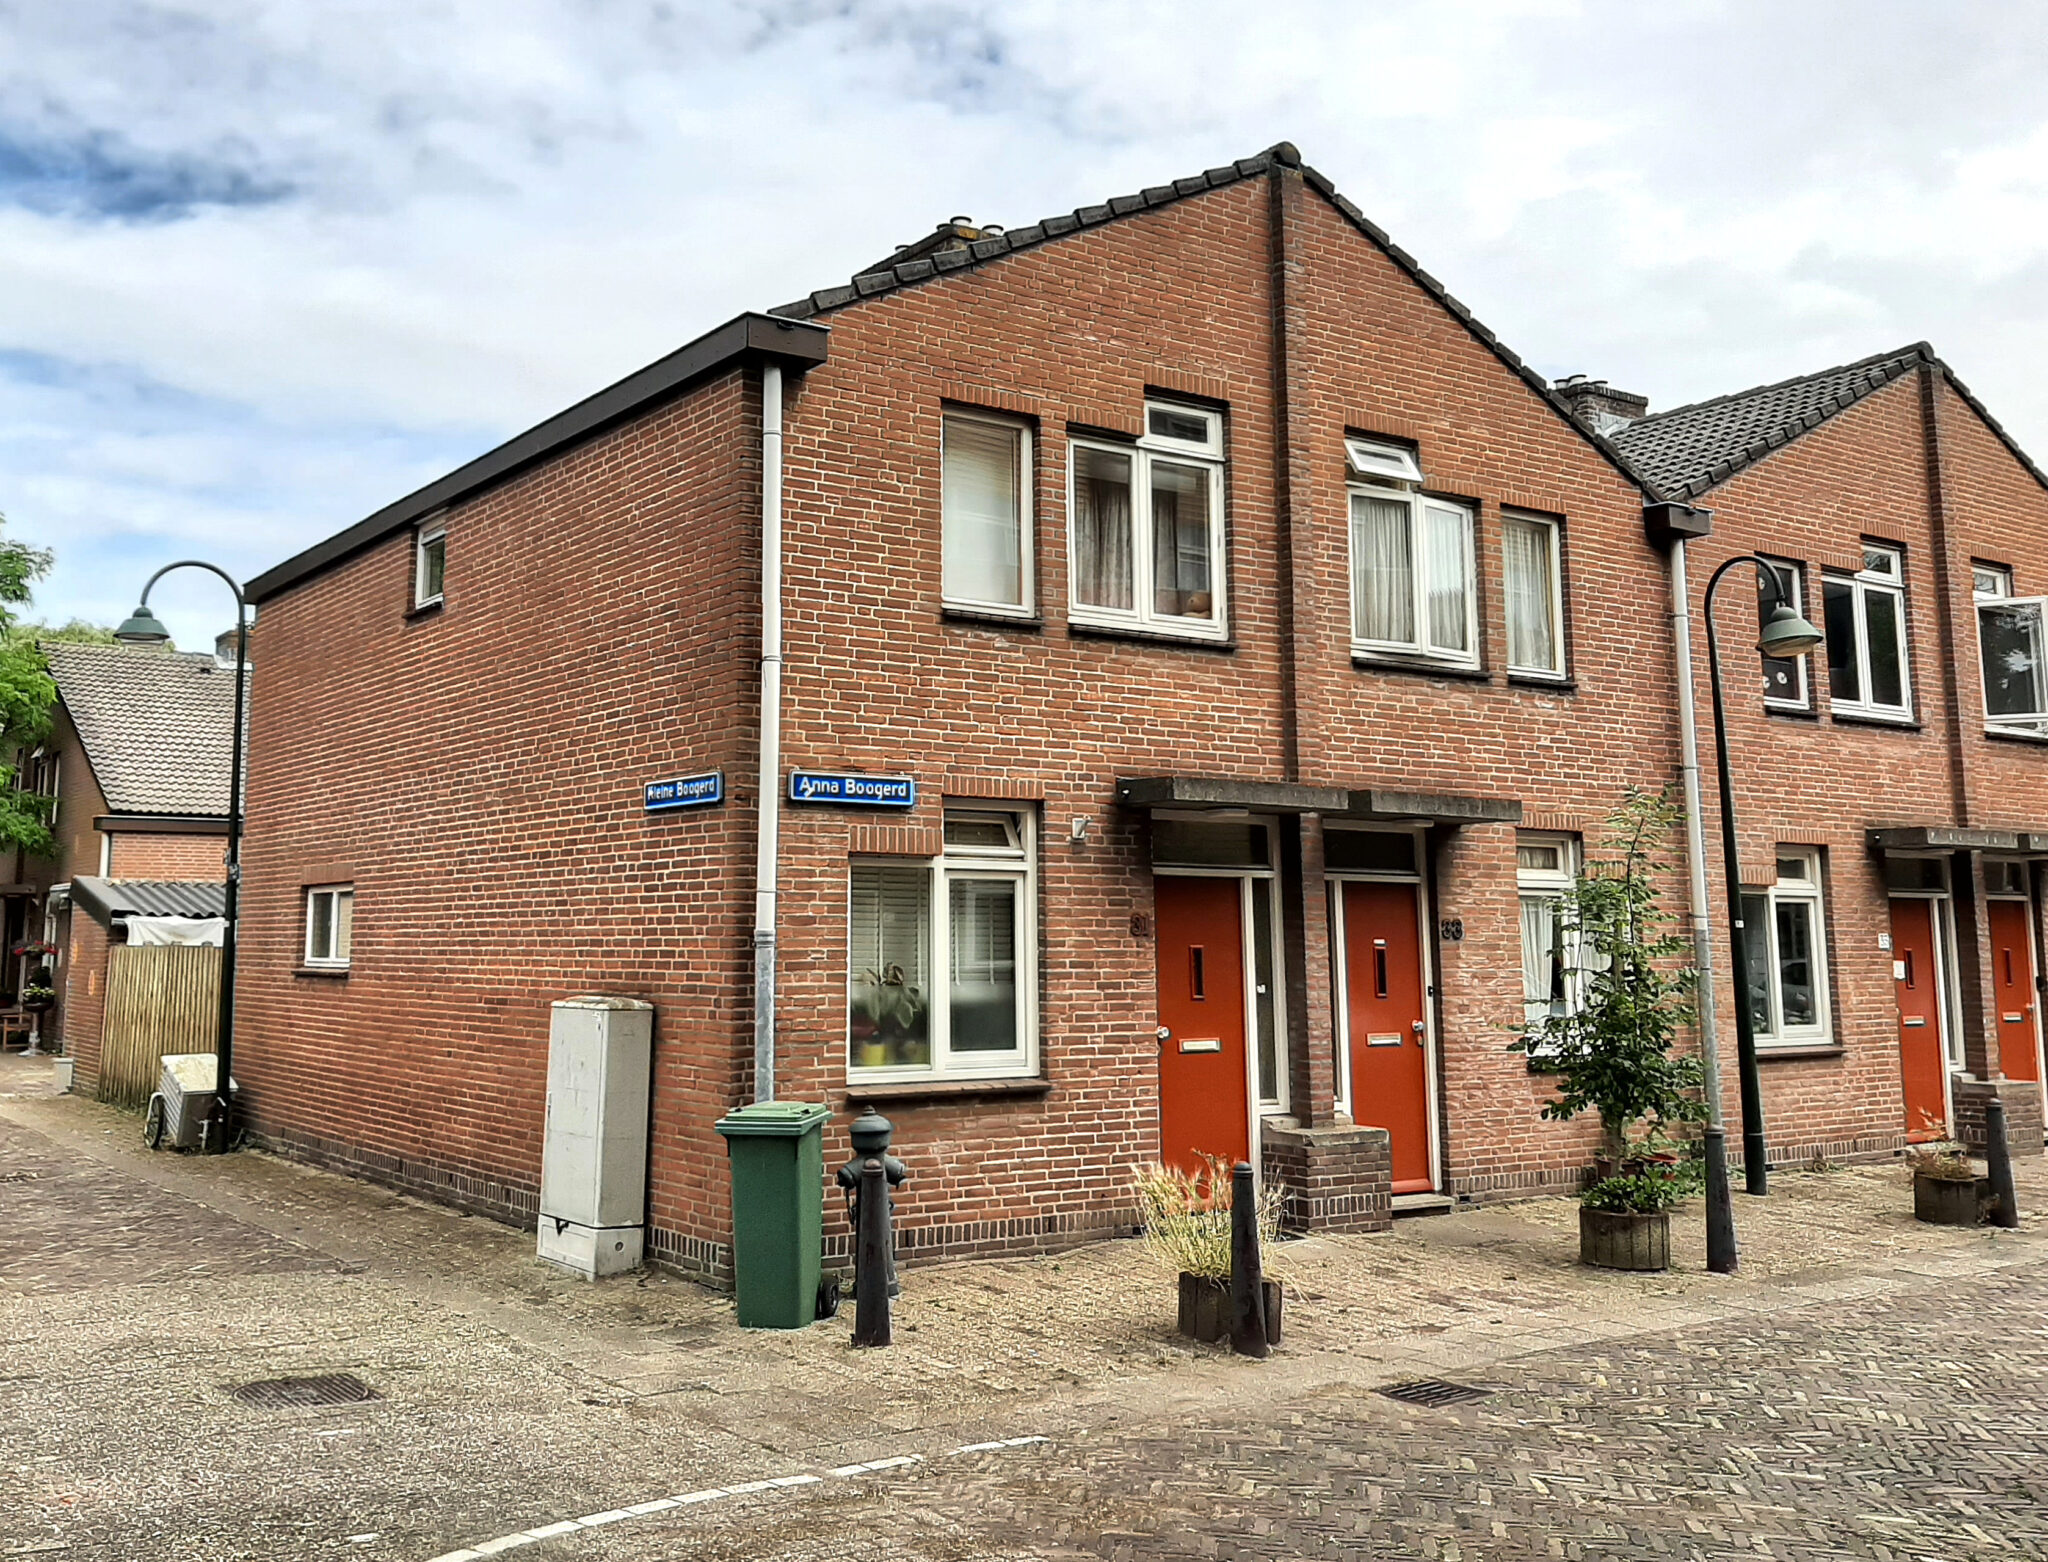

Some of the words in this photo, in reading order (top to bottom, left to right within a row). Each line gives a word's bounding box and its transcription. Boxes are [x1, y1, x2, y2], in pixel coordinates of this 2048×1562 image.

[647, 784, 674, 800] Kleine
[676, 777, 716, 798] Boogerd
[799, 776, 840, 794] Anna
[845, 778, 907, 800] Boogerd
